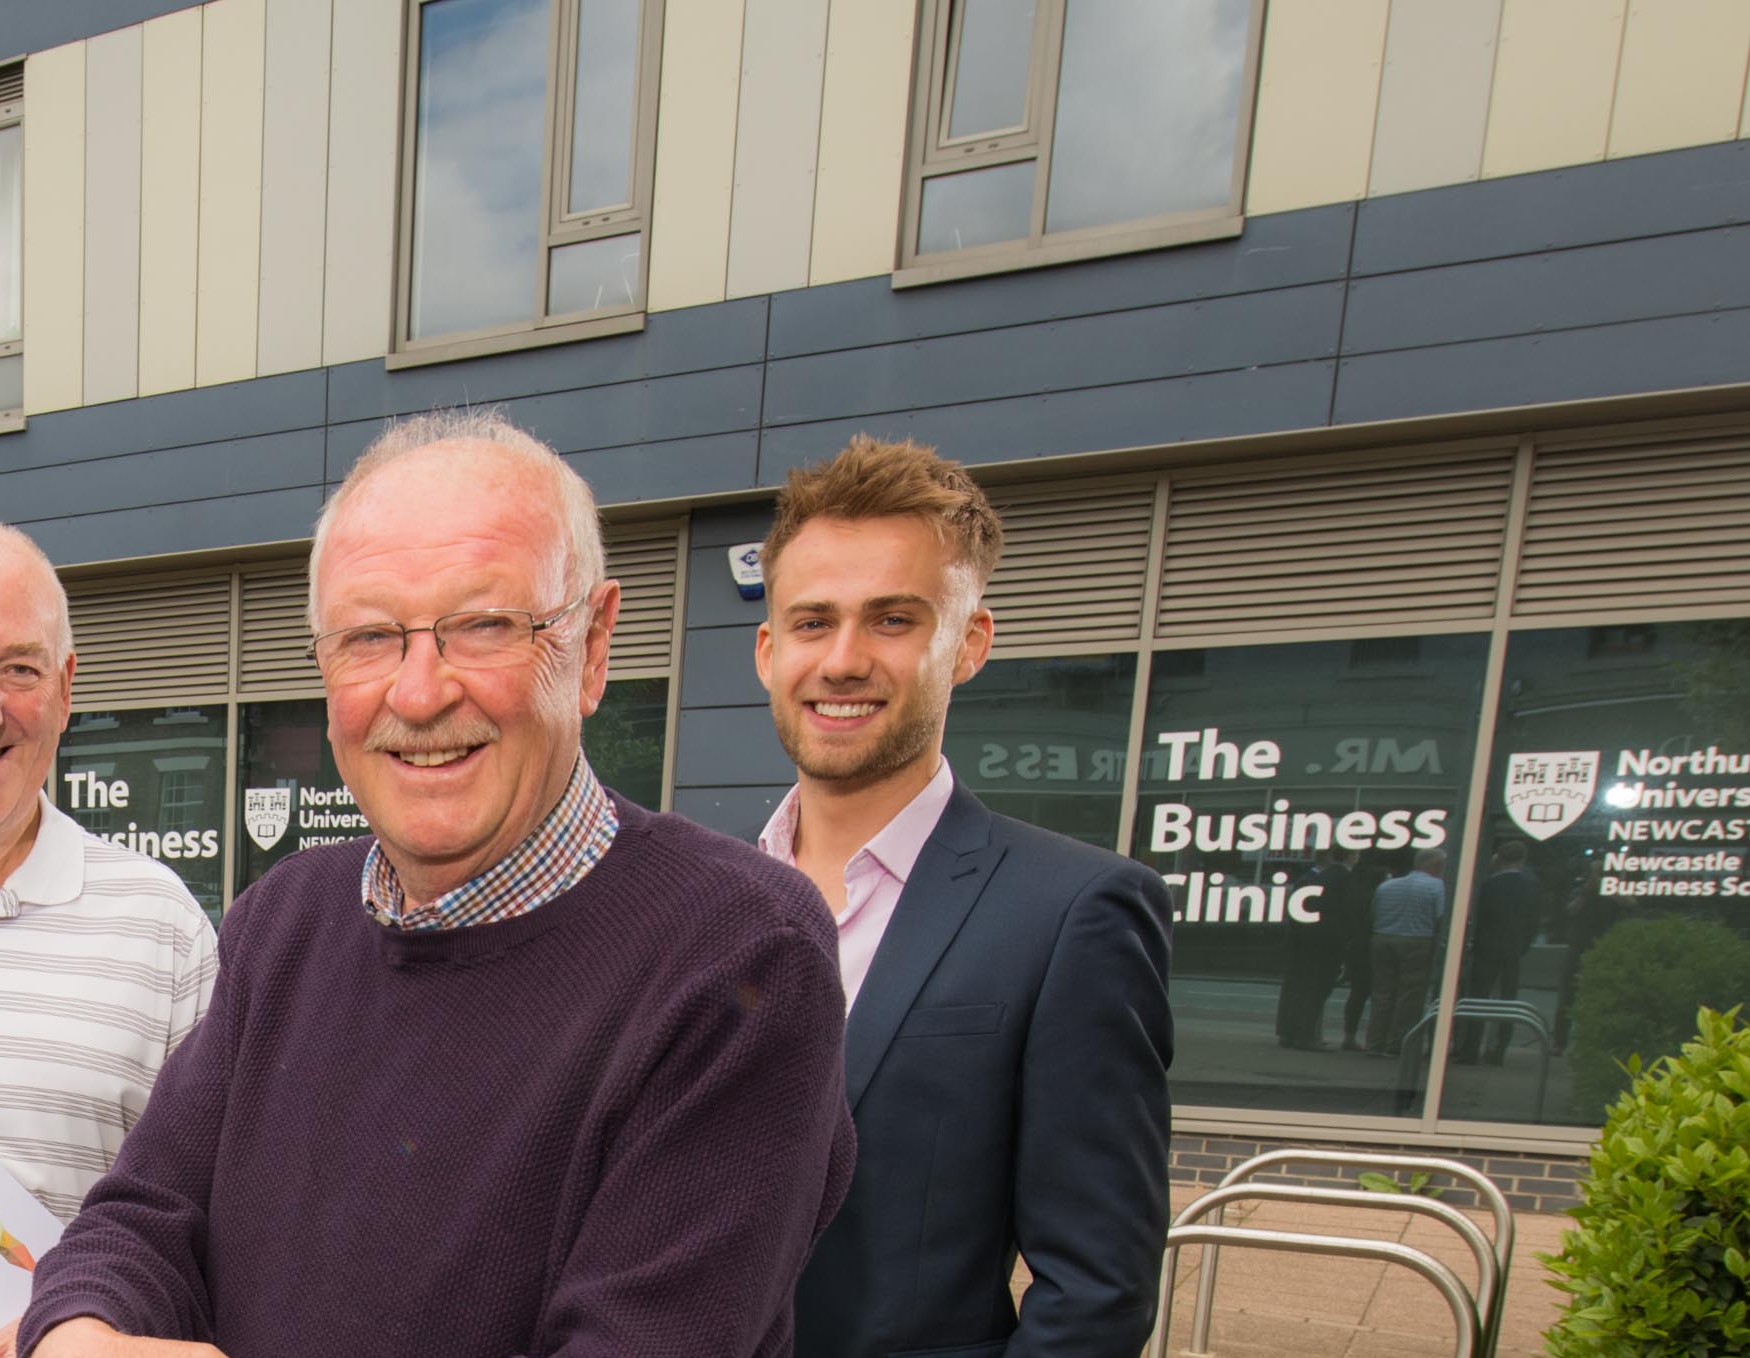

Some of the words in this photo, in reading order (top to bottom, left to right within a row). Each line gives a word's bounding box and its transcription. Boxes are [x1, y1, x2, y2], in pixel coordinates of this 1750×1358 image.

[1158, 728, 1281, 781] The
[1616, 746, 1750, 776] Northu
[64, 771, 130, 808] The
[299, 785, 355, 806] North
[299, 809, 370, 829] Univers
[1150, 799, 1448, 853] Business
[1607, 818, 1750, 841] NEWCAS
[1602, 850, 1741, 873] Newcastle
[1599, 876, 1717, 897] Business
